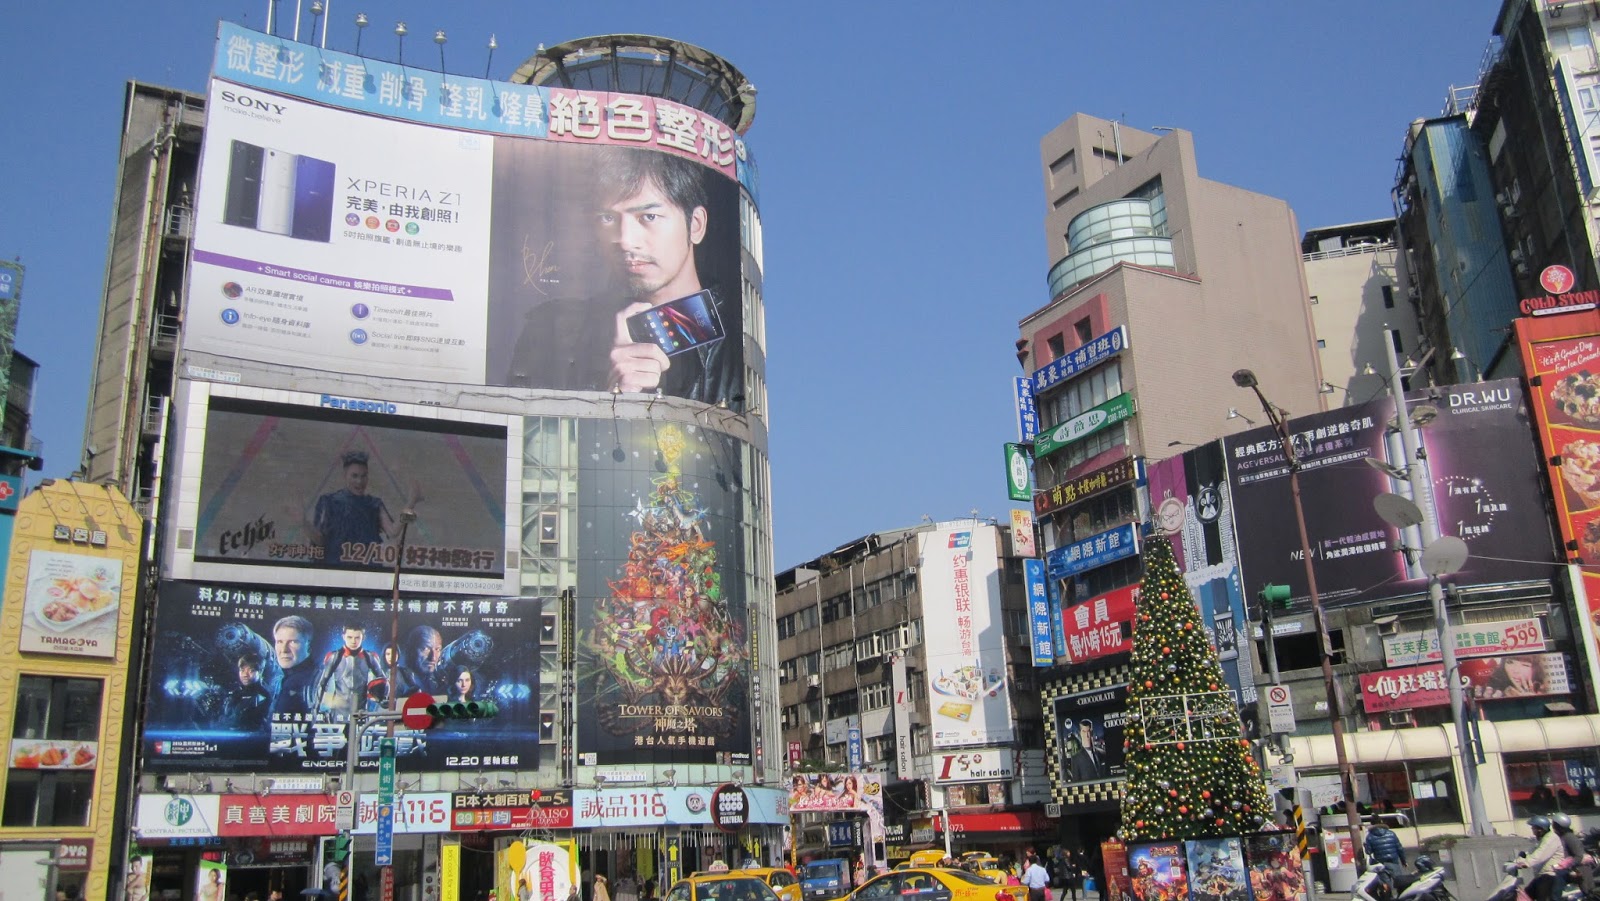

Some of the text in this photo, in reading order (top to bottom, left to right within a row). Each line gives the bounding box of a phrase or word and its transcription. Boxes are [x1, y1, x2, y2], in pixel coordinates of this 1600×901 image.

[227, 34, 543, 128] 微整形 減重 削骨 隆乳 隆鼻
[221, 90, 288, 116] SONY
[346, 176, 462, 206] XPERIA Z1
[264, 265, 292, 280] Smart
[292, 272, 319, 284] social
[319, 277, 351, 289] camera
[1520, 296, 1557, 314] COLD
[1560, 346, 1579, 359] Great
[1579, 341, 1593, 352] Day
[1555, 364, 1567, 374] For
[1567, 359, 1577, 369] Ice
[320, 393, 397, 414] Panasonic
[1450, 388, 1511, 407] DR.WU
[1452, 402, 1512, 415] CLINICAL SKINCARE
[1237, 454, 1285, 470] AGEVERSAL
[340, 541, 397, 566] 12/10
[198, 587, 360, 612] 科幻小說最高榮譽得主
[953, 554, 972, 657] 约惠银联 畅游台湾
[1074, 598, 1110, 630] 會員
[41, 636, 98, 647] TAMAGOYA
[1070, 621, 1122, 657] 每小時15元
[1390, 639, 1428, 656] 玉芙蓉
[1473, 632, 1500, 645] 會館
[1500, 626, 1538, 652] $599
[618, 704, 662, 716] TOWER
[682, 704, 723, 717] SAVIORS
[654, 717, 698, 733] 神魔之塔
[634, 735, 715, 746] 港台人氣手機遊戲
[446, 756, 479, 766] 12.20
[970, 768, 1011, 778] hair salon
[719, 792, 743, 801] ROCK
[225, 804, 336, 824] 真善美劇院
[530, 808, 569, 819] DAISO
[581, 793, 667, 819] 誠品116
[719, 802, 743, 812] COCO
[537, 817, 560, 826] JAPAN
